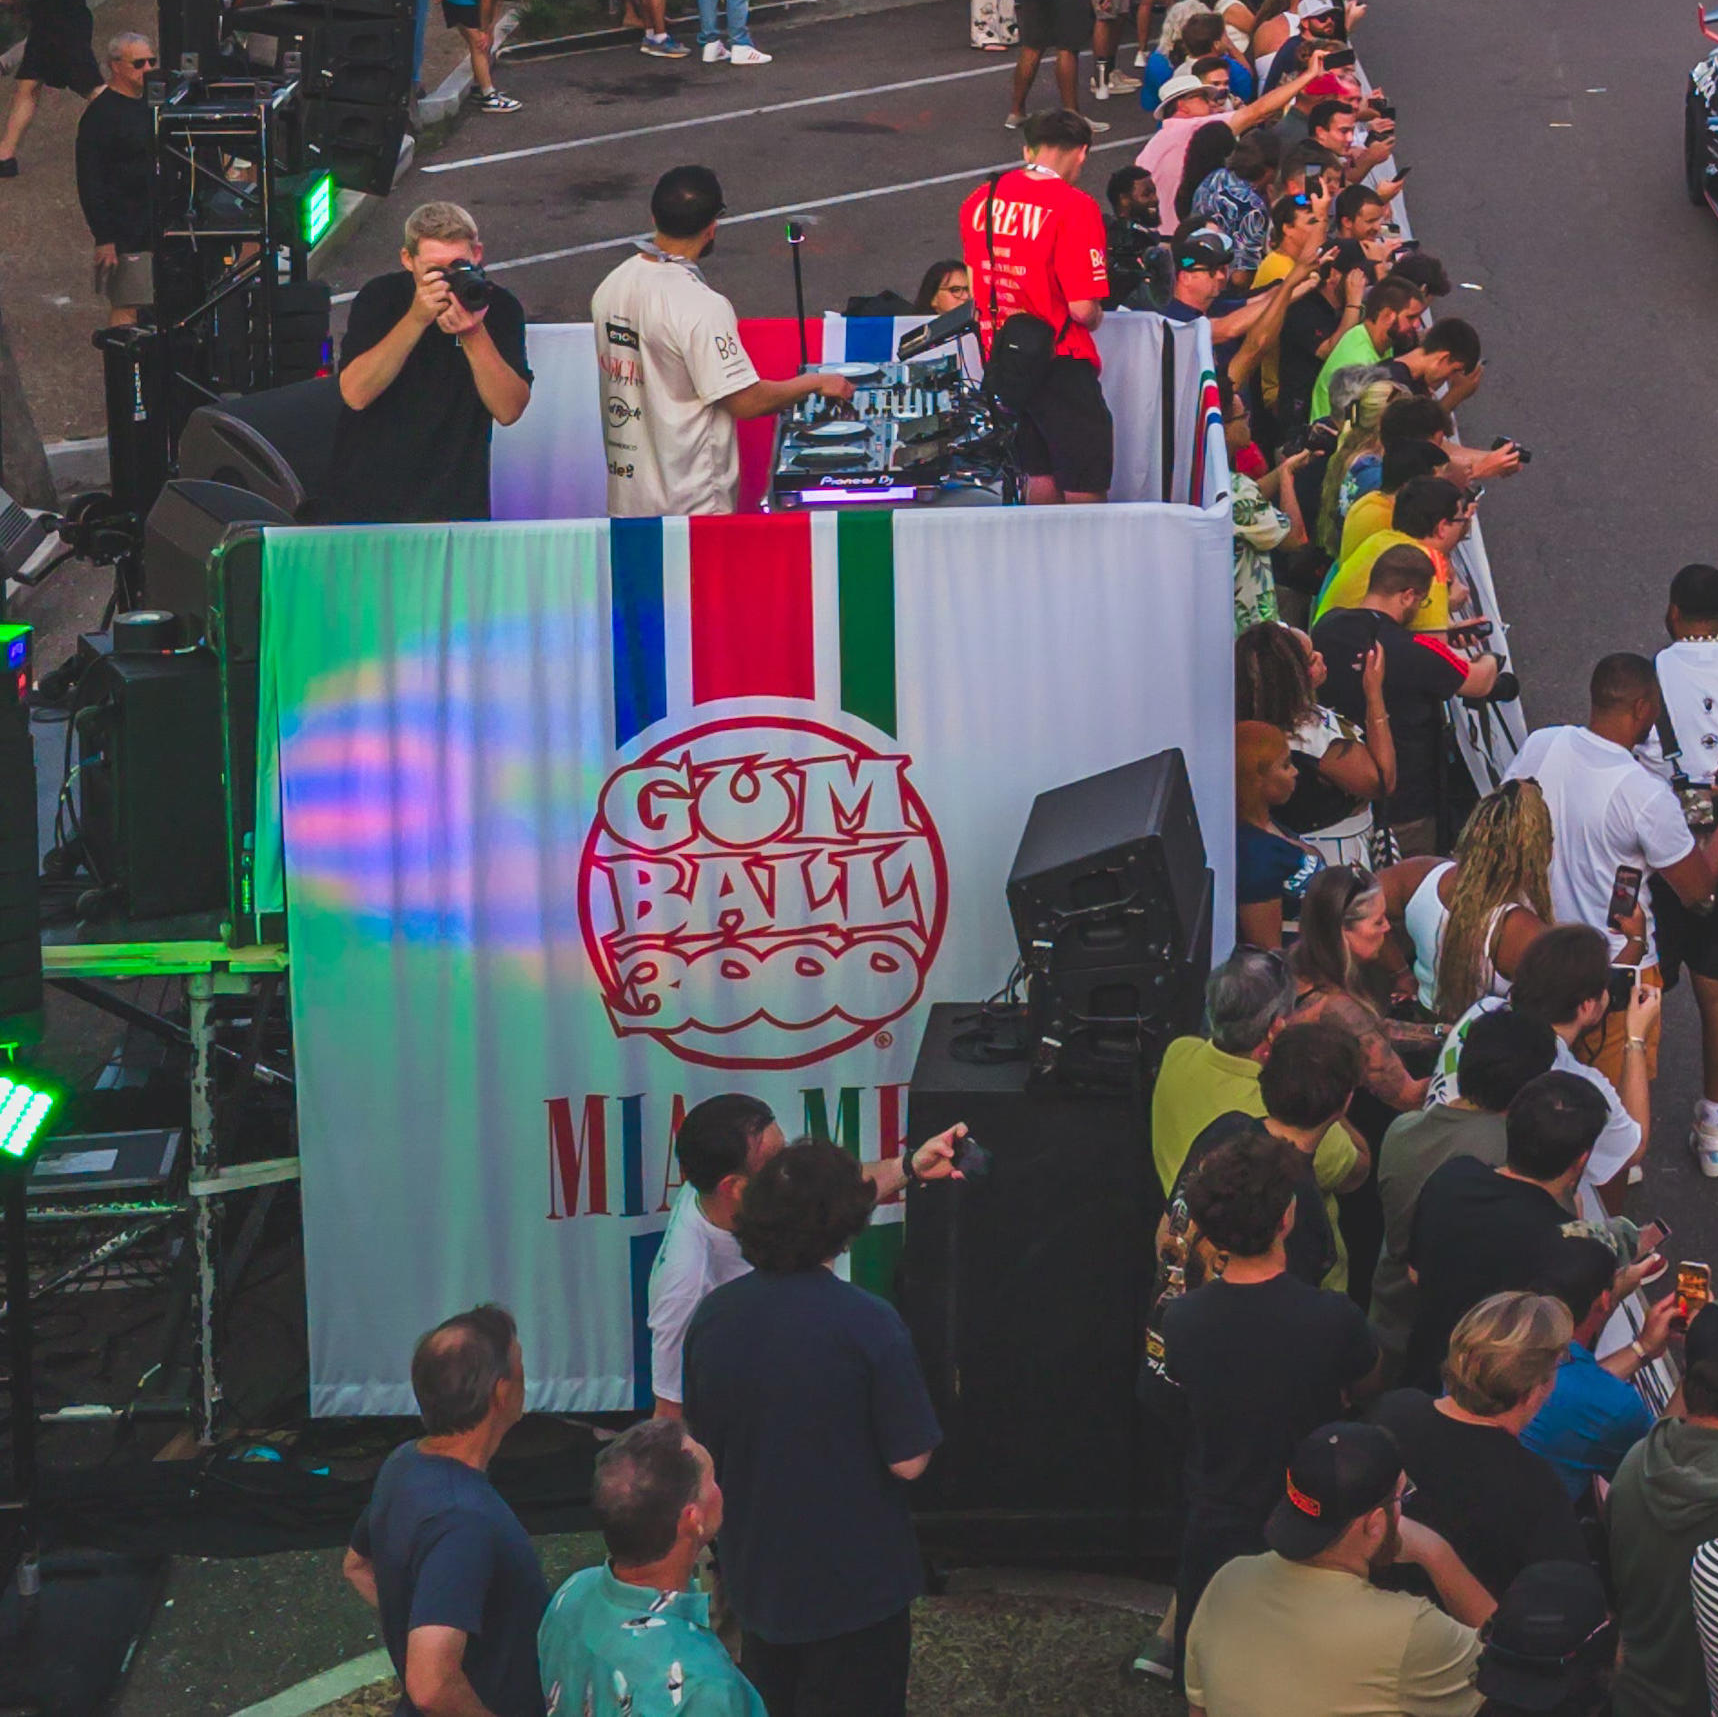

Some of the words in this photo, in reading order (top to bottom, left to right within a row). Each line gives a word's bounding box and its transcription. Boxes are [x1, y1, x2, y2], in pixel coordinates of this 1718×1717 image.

[971, 195, 1054, 242] CREW
[600, 748, 928, 855] GUM
[592, 839, 930, 948] BALL
